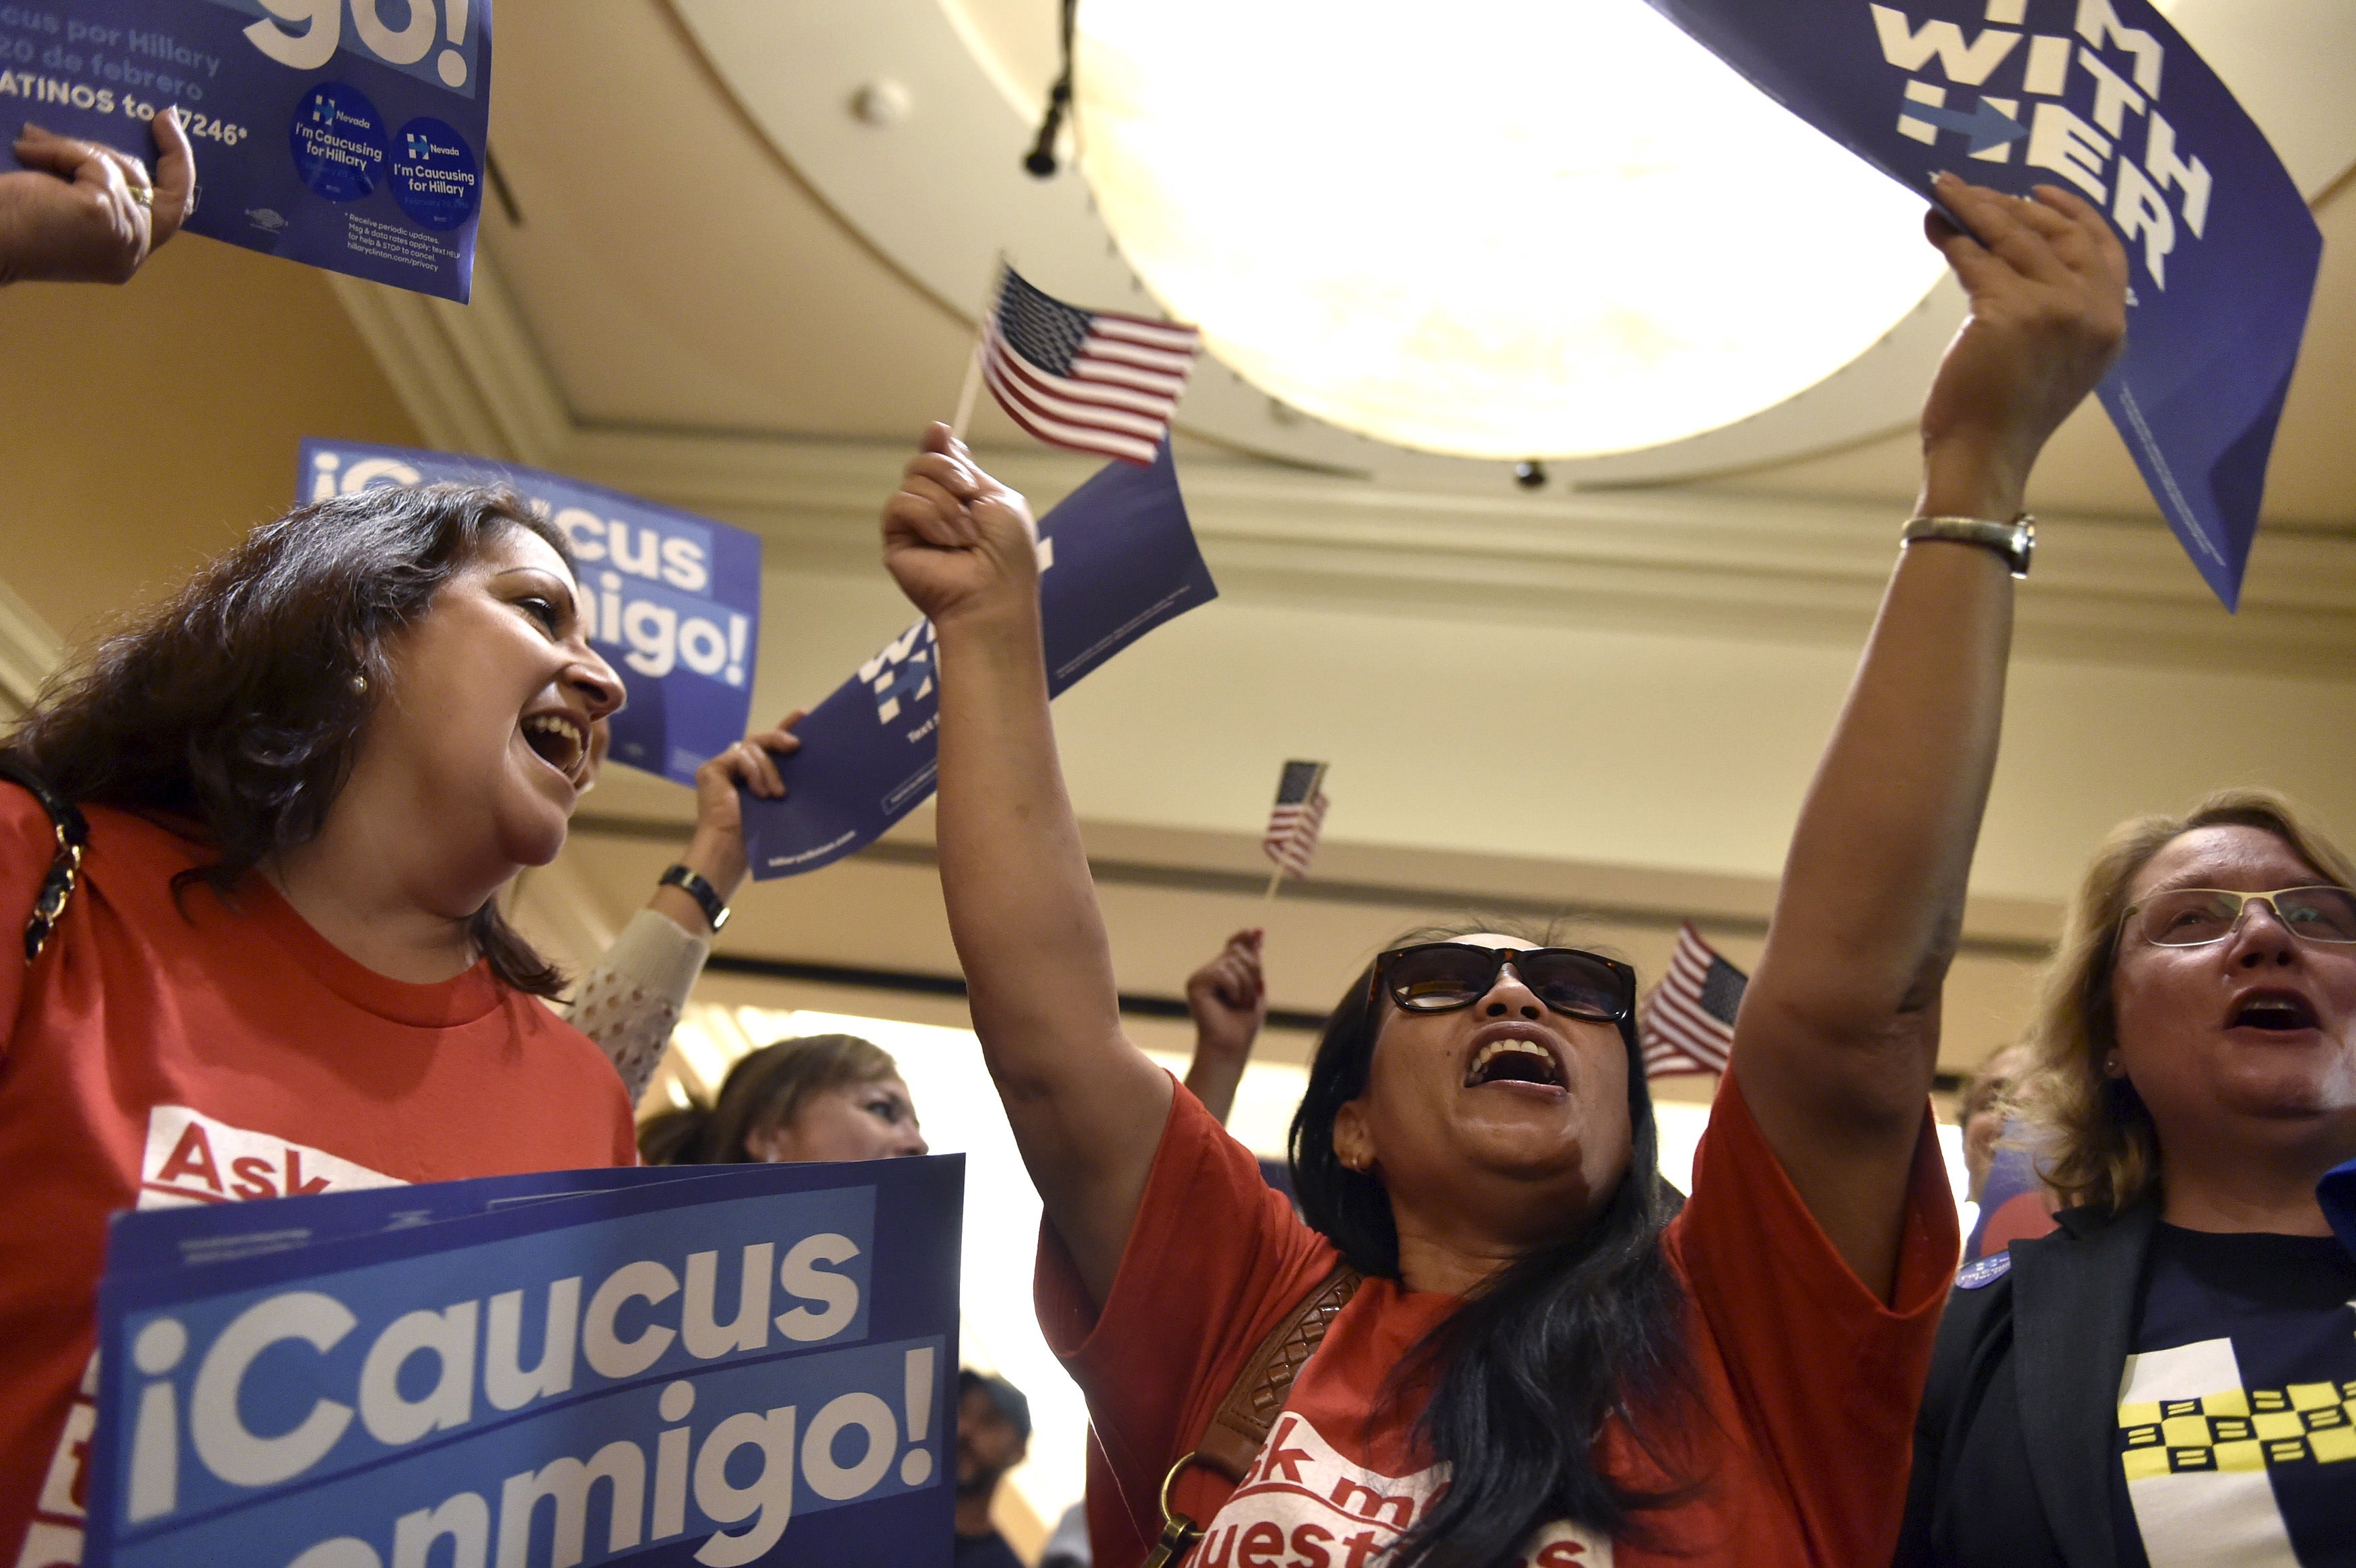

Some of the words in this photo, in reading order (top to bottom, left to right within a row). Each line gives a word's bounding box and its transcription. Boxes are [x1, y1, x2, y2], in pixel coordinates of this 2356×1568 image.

[128, 28, 221, 78] Hillary
[42, 45, 83, 73] de
[92, 52, 203, 101] febrero
[0, 69, 116, 114] ATINOS
[122, 94, 155, 122] to
[336, 110, 370, 129] Nevada
[1869, 2, 2212, 240] WITH
[296, 122, 314, 139] I'm
[315, 129, 382, 162] Caucusing
[306, 141, 324, 157] for
[325, 146, 368, 172] Hillary
[430, 144, 459, 156] Nevada
[394, 164, 413, 176] I'm
[415, 166, 475, 186] Caucusing
[409, 178, 427, 191] for
[429, 181, 464, 198] Hillary
[1897, 79, 2176, 292] HER
[349, 213, 378, 227] Receive
[378, 223, 407, 236] periodic
[409, 231, 440, 244] updates.
[349, 223, 363, 234] Msg
[364, 227, 370, 235] &
[371, 229, 388, 240] data
[389, 235, 408, 245] rates
[432, 245, 446, 255] text
[446, 250, 460, 259] HELP
[349, 232, 358, 240] for
[359, 236, 375, 247] help
[376, 240, 382, 248] &
[382, 242, 401, 252] STOP
[411, 250, 436, 261] cancel.
[347, 241, 438, 273] hillaryclinton.com/privacy
[157, 1121, 332, 1202] Ask
[130, 1233, 861, 1524] ¡Caucus
[285, 1347, 934, 1568] nmigo!
